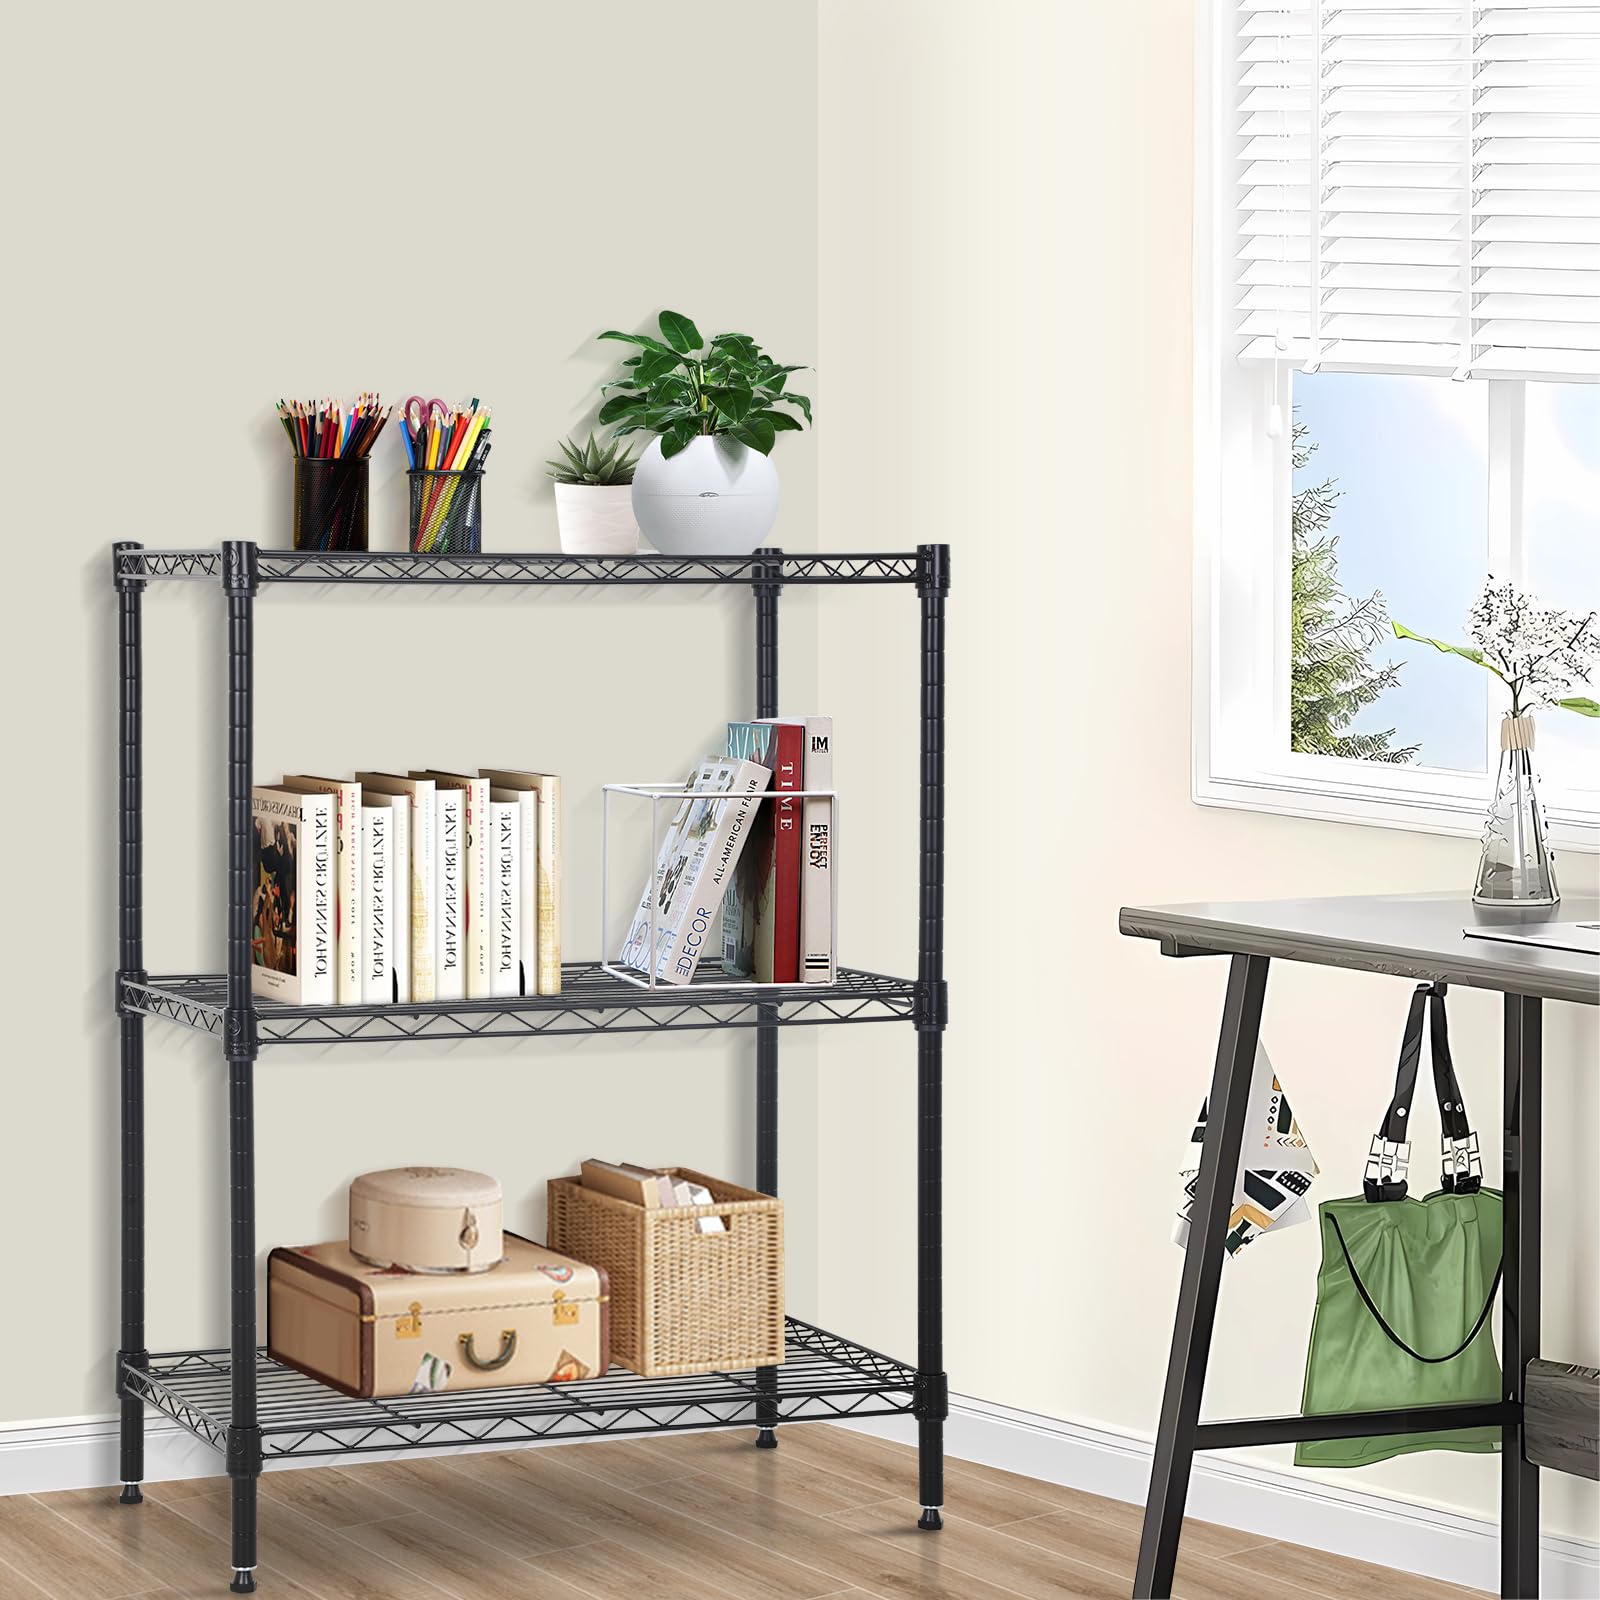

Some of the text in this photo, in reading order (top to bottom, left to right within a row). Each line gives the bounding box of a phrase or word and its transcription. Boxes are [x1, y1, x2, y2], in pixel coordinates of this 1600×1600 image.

[780, 762, 794, 831] TIME
[713, 811, 745, 885] ALL-AMERICAN
[809, 824, 820, 869] ENJOY
[819, 824, 829, 869] PERFECT
[677, 907, 712, 971] DECOR
